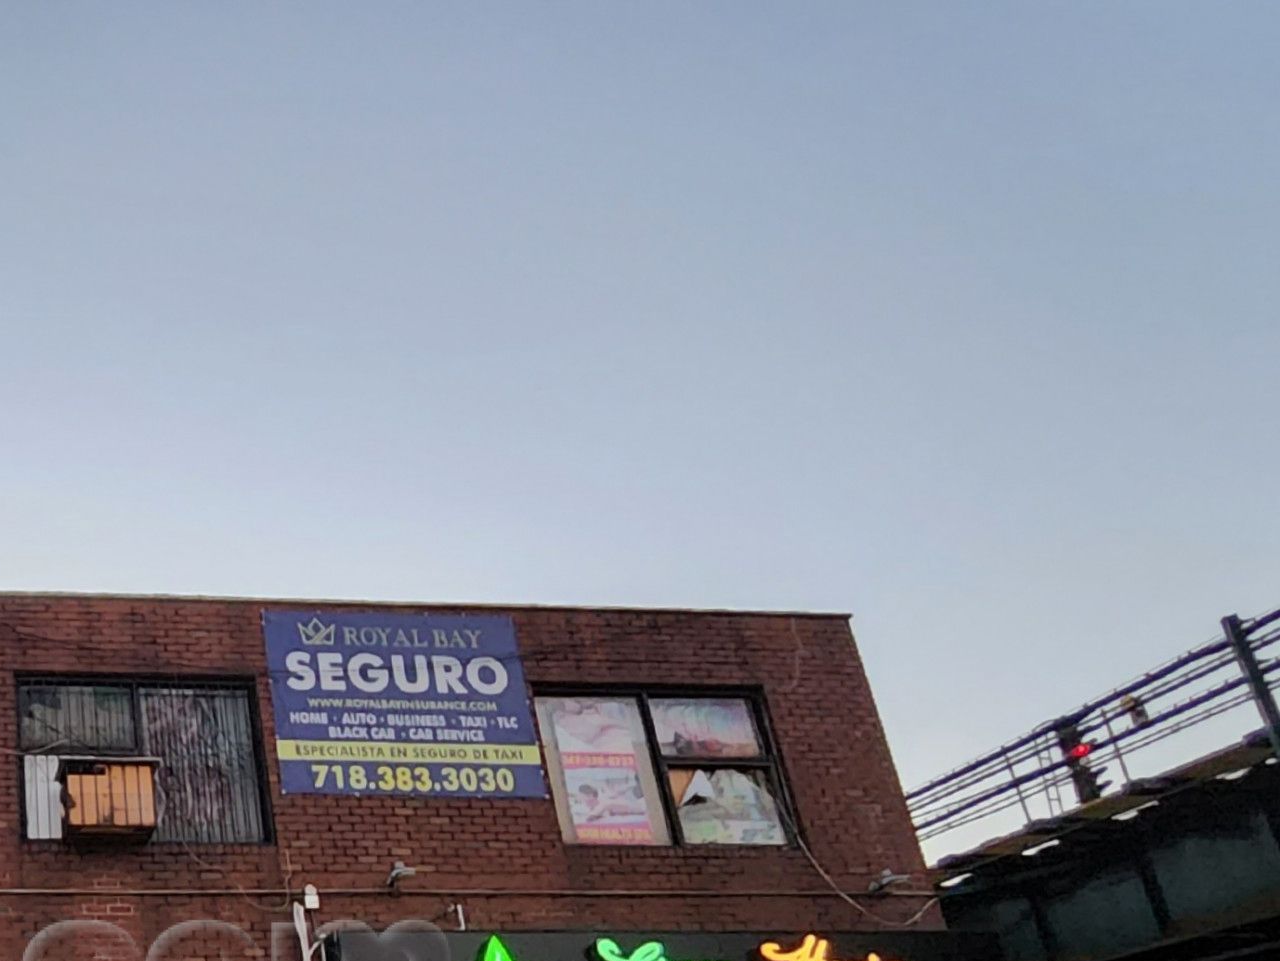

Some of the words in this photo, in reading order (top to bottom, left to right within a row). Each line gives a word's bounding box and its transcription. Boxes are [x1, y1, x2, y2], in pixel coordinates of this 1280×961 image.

[343, 626, 428, 647] ROYAL
[434, 629, 482, 649] BAY
[285, 651, 508, 695] SEGURO
[290, 712, 328, 724] HOME
[342, 713, 376, 725] AUTO
[387, 714, 446, 727] BUSINESS
[459, 715, 487, 728] TAXI
[328, 726, 368, 740] BLACK
[371, 727, 395, 740] CAR
[409, 728, 433, 741] CAR
[437, 729, 485, 742] SERVICE
[295, 744, 385, 758] ESPECIALISTA
[390, 746, 407, 758] EN
[413, 747, 467, 759] SEGURO
[473, 748, 489, 760] DE
[493, 749, 523, 760] TAXI
[311, 765, 515, 792] 718.383.3030
